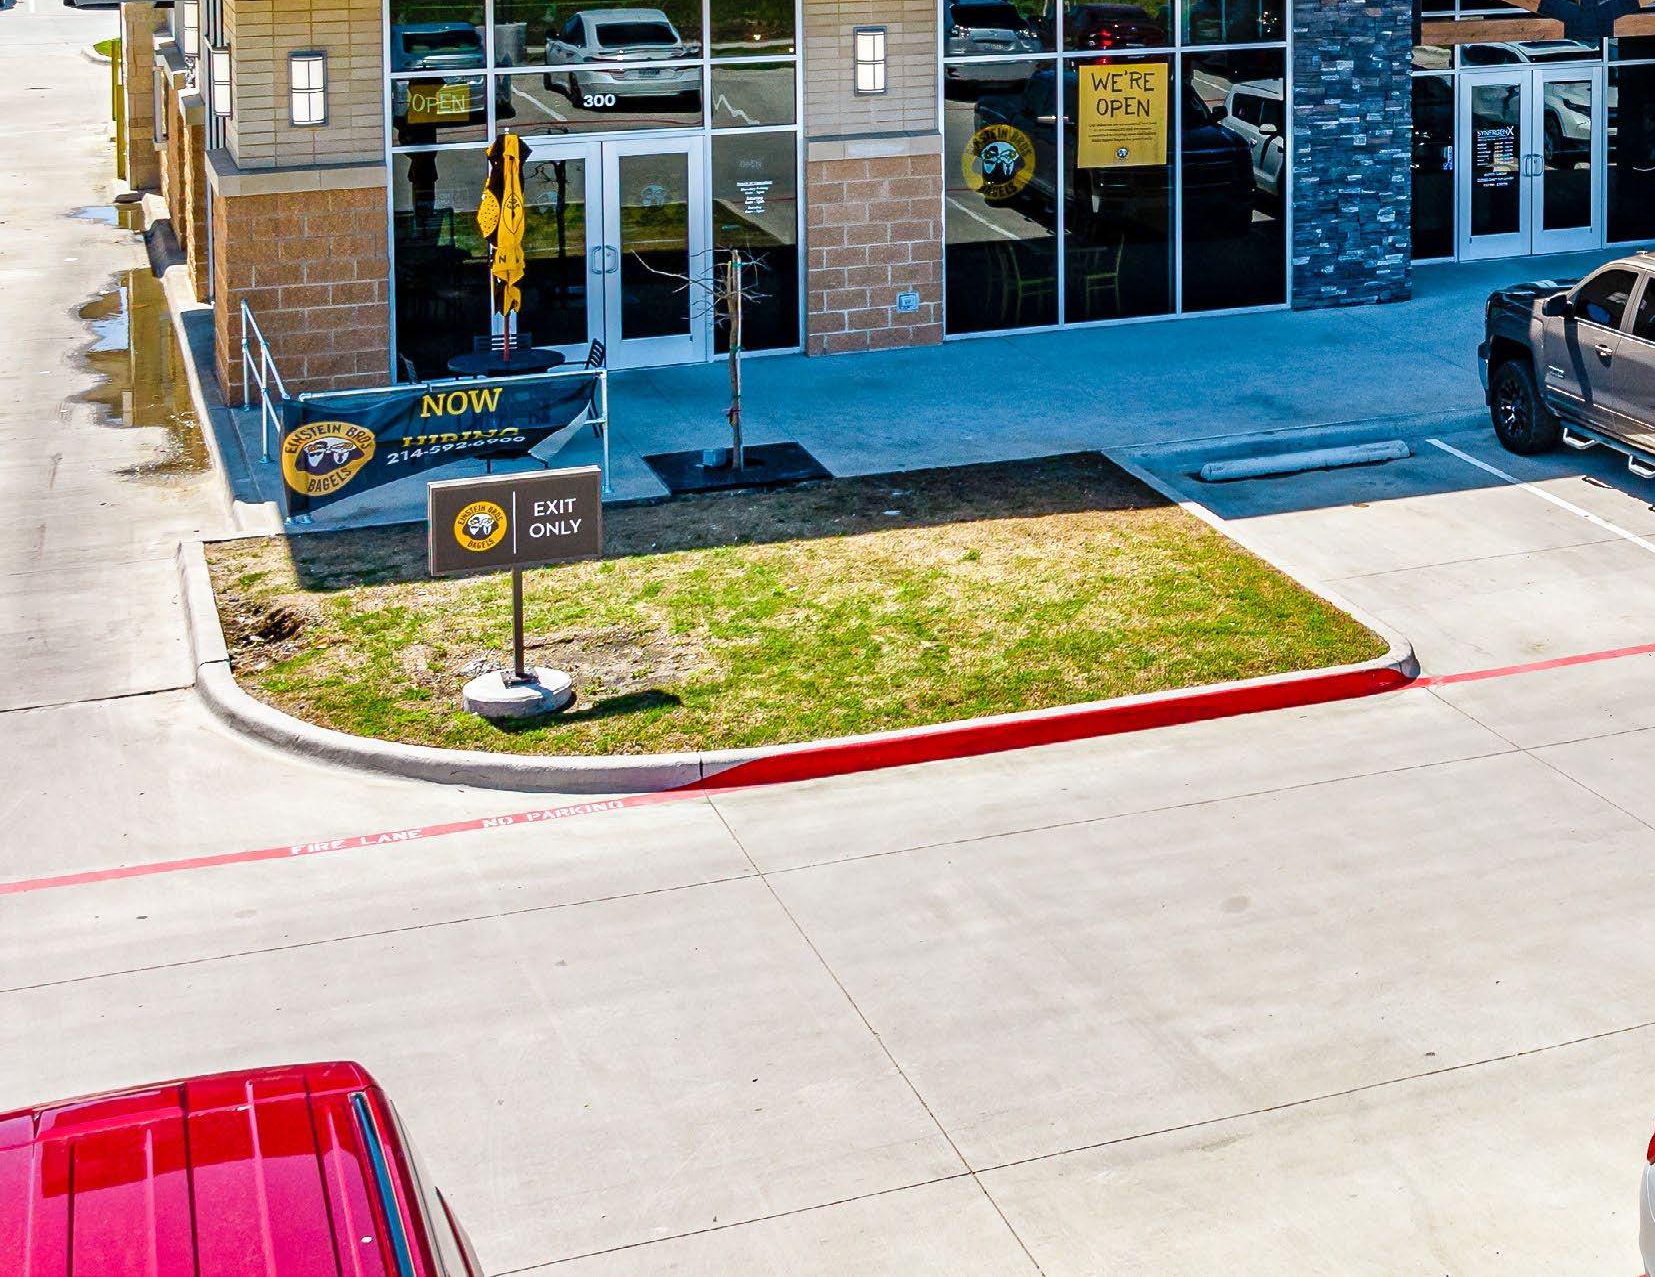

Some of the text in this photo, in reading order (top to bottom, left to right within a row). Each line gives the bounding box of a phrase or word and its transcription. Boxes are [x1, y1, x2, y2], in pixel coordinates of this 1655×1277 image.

[1091, 69, 1156, 93] WE'RE
[411, 93, 465, 112] OPEN
[583, 93, 616, 107] 300
[1096, 97, 1151, 118] OPEN
[420, 388, 503, 418] NOW
[284, 423, 372, 455] EINSTEIN BROS
[307, 468, 352, 493] BAGELS
[457, 505, 486, 526] EINSTEIN
[534, 498, 577, 517] EXIT
[529, 518, 582, 538] ONLY
[467, 538, 495, 549] BAGELS
[291, 800, 625, 855] FIRE LANE NO PARKING
